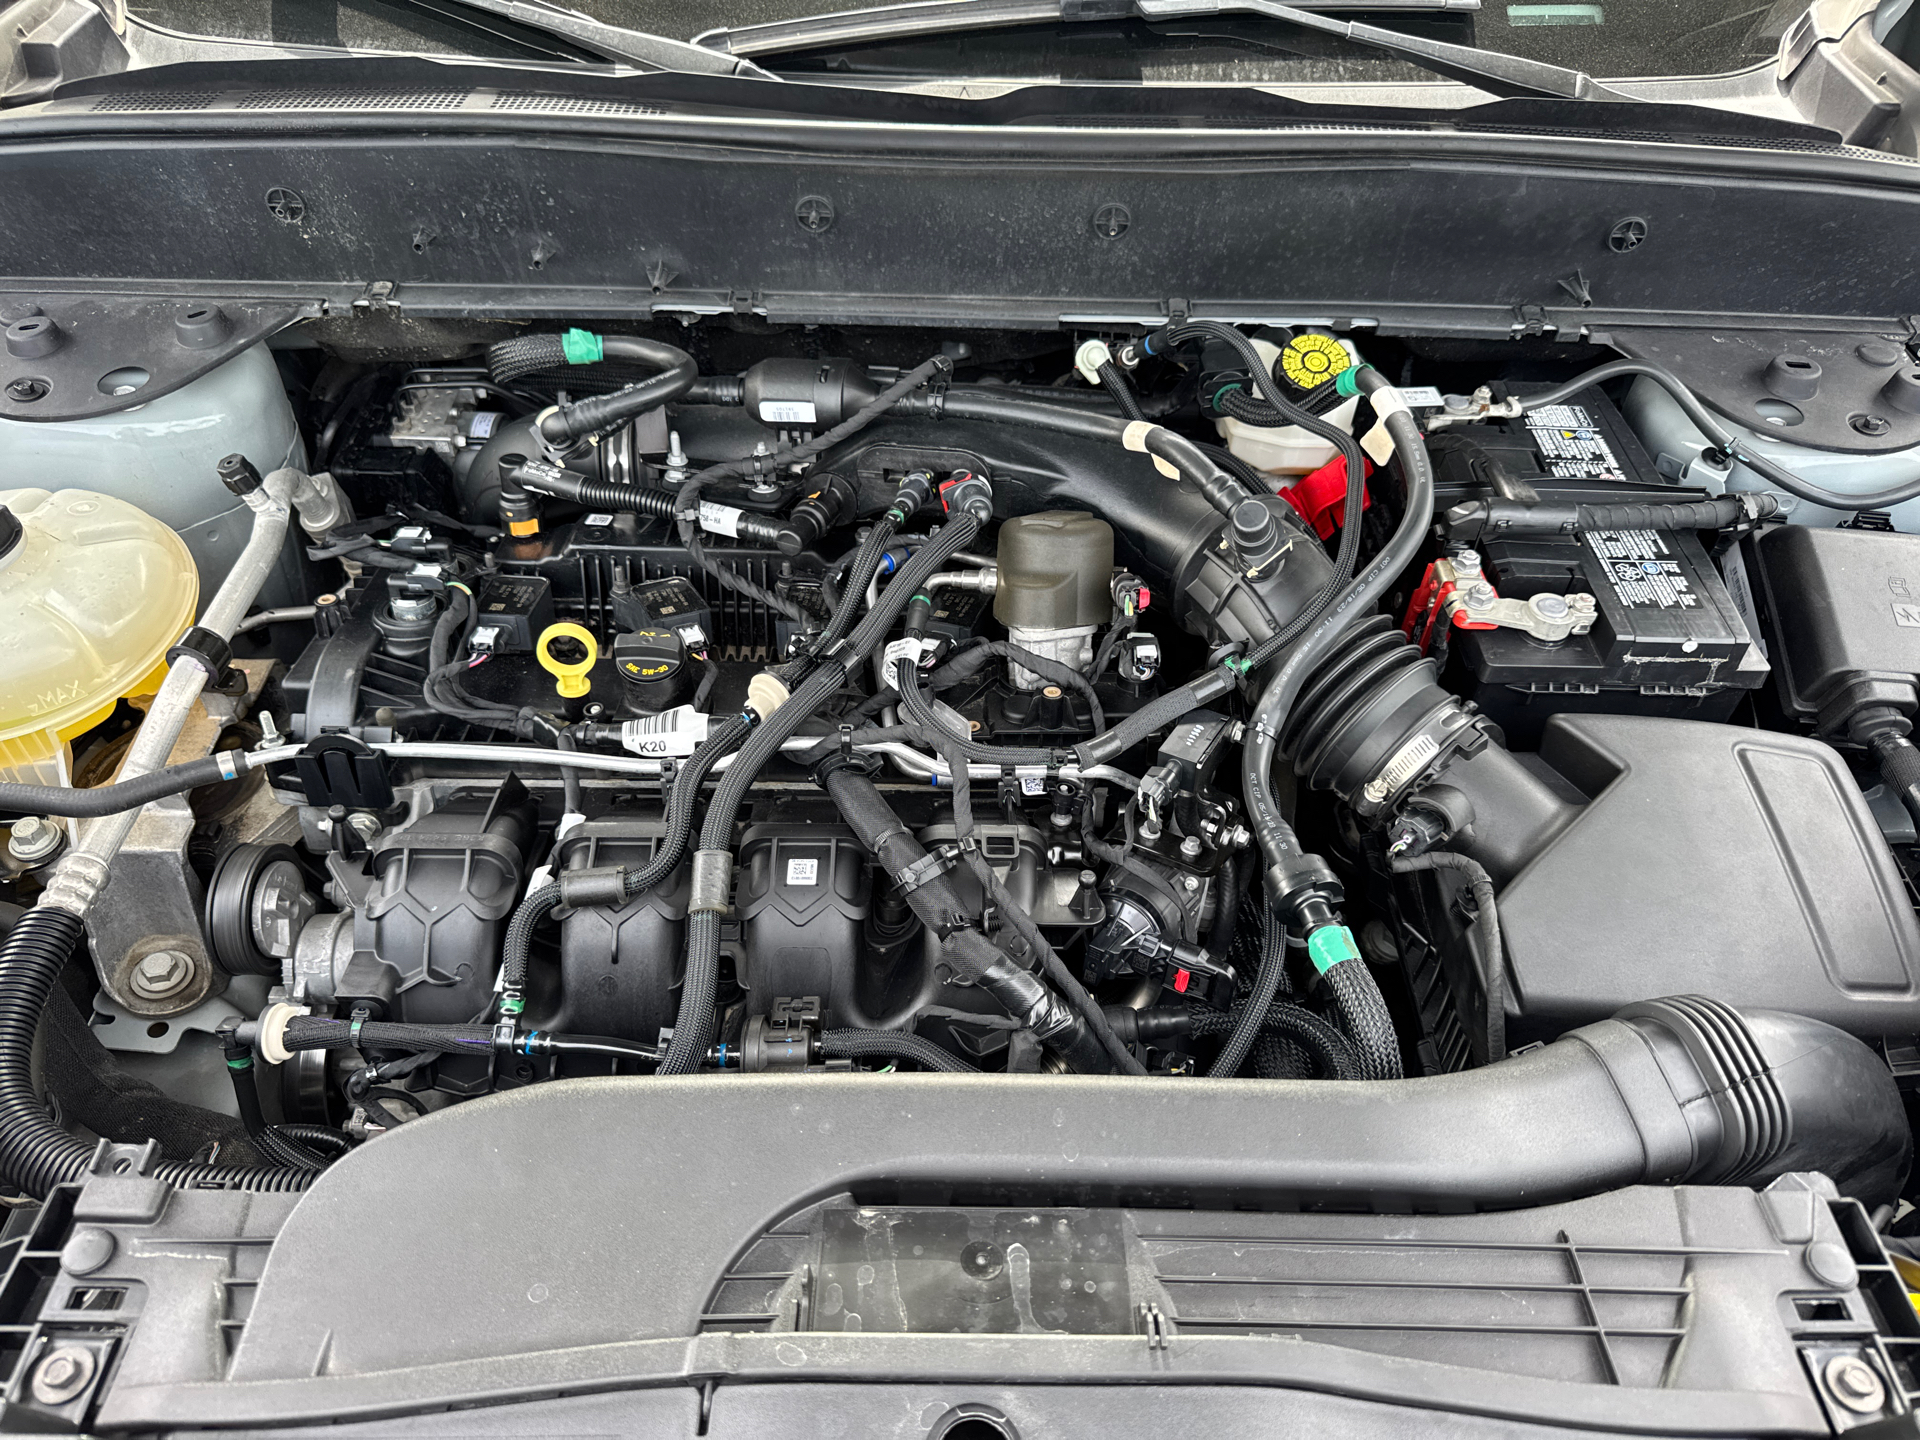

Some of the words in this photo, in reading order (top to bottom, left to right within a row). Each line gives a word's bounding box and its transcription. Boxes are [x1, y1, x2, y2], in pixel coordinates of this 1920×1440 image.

[1367, 569, 1379, 582] CIP
[1336, 583, 1366, 613] 05/18/23
[625, 662, 640, 674] SAE
[641, 664, 669, 675] 5W-30
[37, 680, 86, 709] MAX
[639, 740, 666, 753] K20
